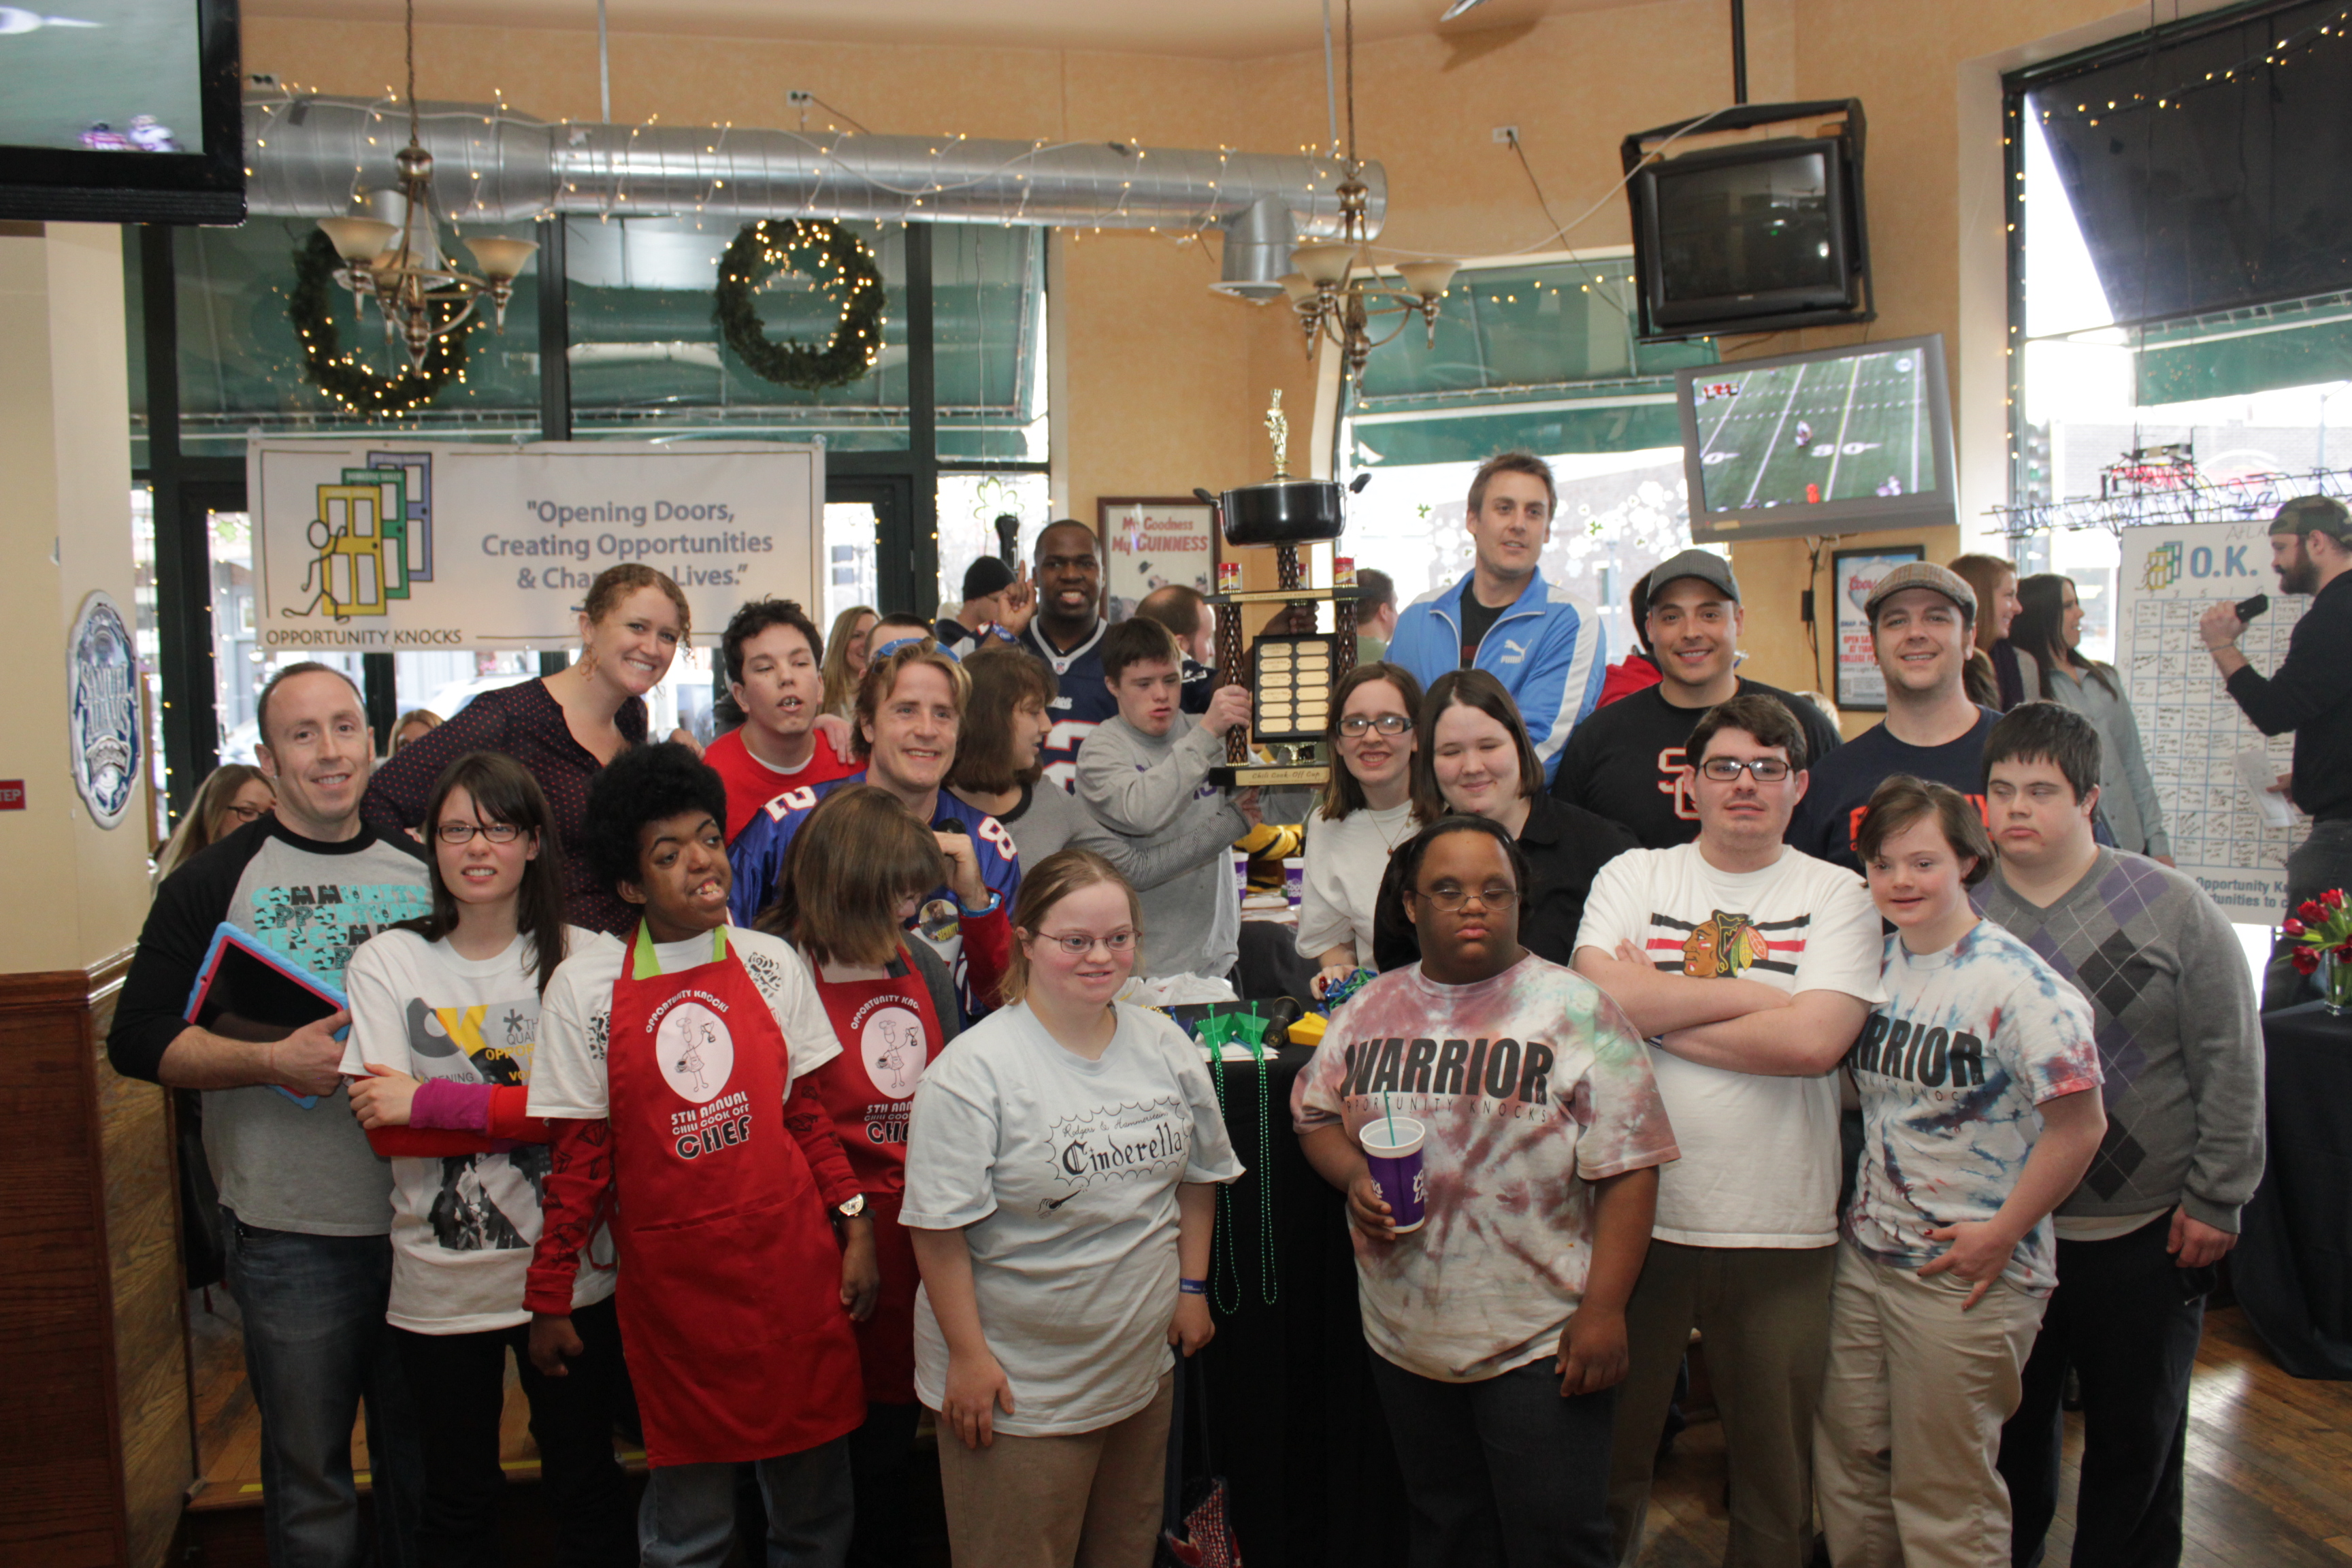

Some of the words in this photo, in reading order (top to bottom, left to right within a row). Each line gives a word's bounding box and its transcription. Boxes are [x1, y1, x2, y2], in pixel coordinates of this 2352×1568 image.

[527, 500, 647, 527] "Opening
[654, 500, 734, 523] Doors,
[1144, 517, 1193, 531] Goodness
[482, 534, 590, 561] Creating
[597, 532, 773, 560] Opportunities
[1112, 536, 1130, 555] My
[1137, 533, 1208, 552] GUINNESS
[2190, 545, 2258, 578] O.K.
[517, 568, 536, 589] &
[265, 630, 390, 645] OPPORTUNITY
[394, 629, 462, 644] KNOCKS
[978, 816, 1017, 861] 8
[250, 884, 428, 908] COMMUNITY
[2264, 896, 2276, 908] to
[646, 990, 691, 1033] OPPORTUNITY
[693, 990, 730, 1013] KNOCKS
[851, 994, 899, 1030] OPPORTUNITY
[1340, 1038, 1554, 1106] WARRIOR
[671, 1109, 696, 1126] 5TH
[700, 1090, 748, 1118] ANNUAL
[672, 1123, 698, 1135] CHILI
[700, 1110, 731, 1127] COOK
[732, 1096, 749, 1116] OFF
[866, 1104, 889, 1114] 5TH
[1469, 1099, 1546, 1123] KNOCKS
[676, 1114, 753, 1160] CHEF
[1062, 1124, 1095, 1139] Rodgers
[1100, 1122, 1109, 1132] &
[1062, 1122, 1182, 1176] Cinderella
